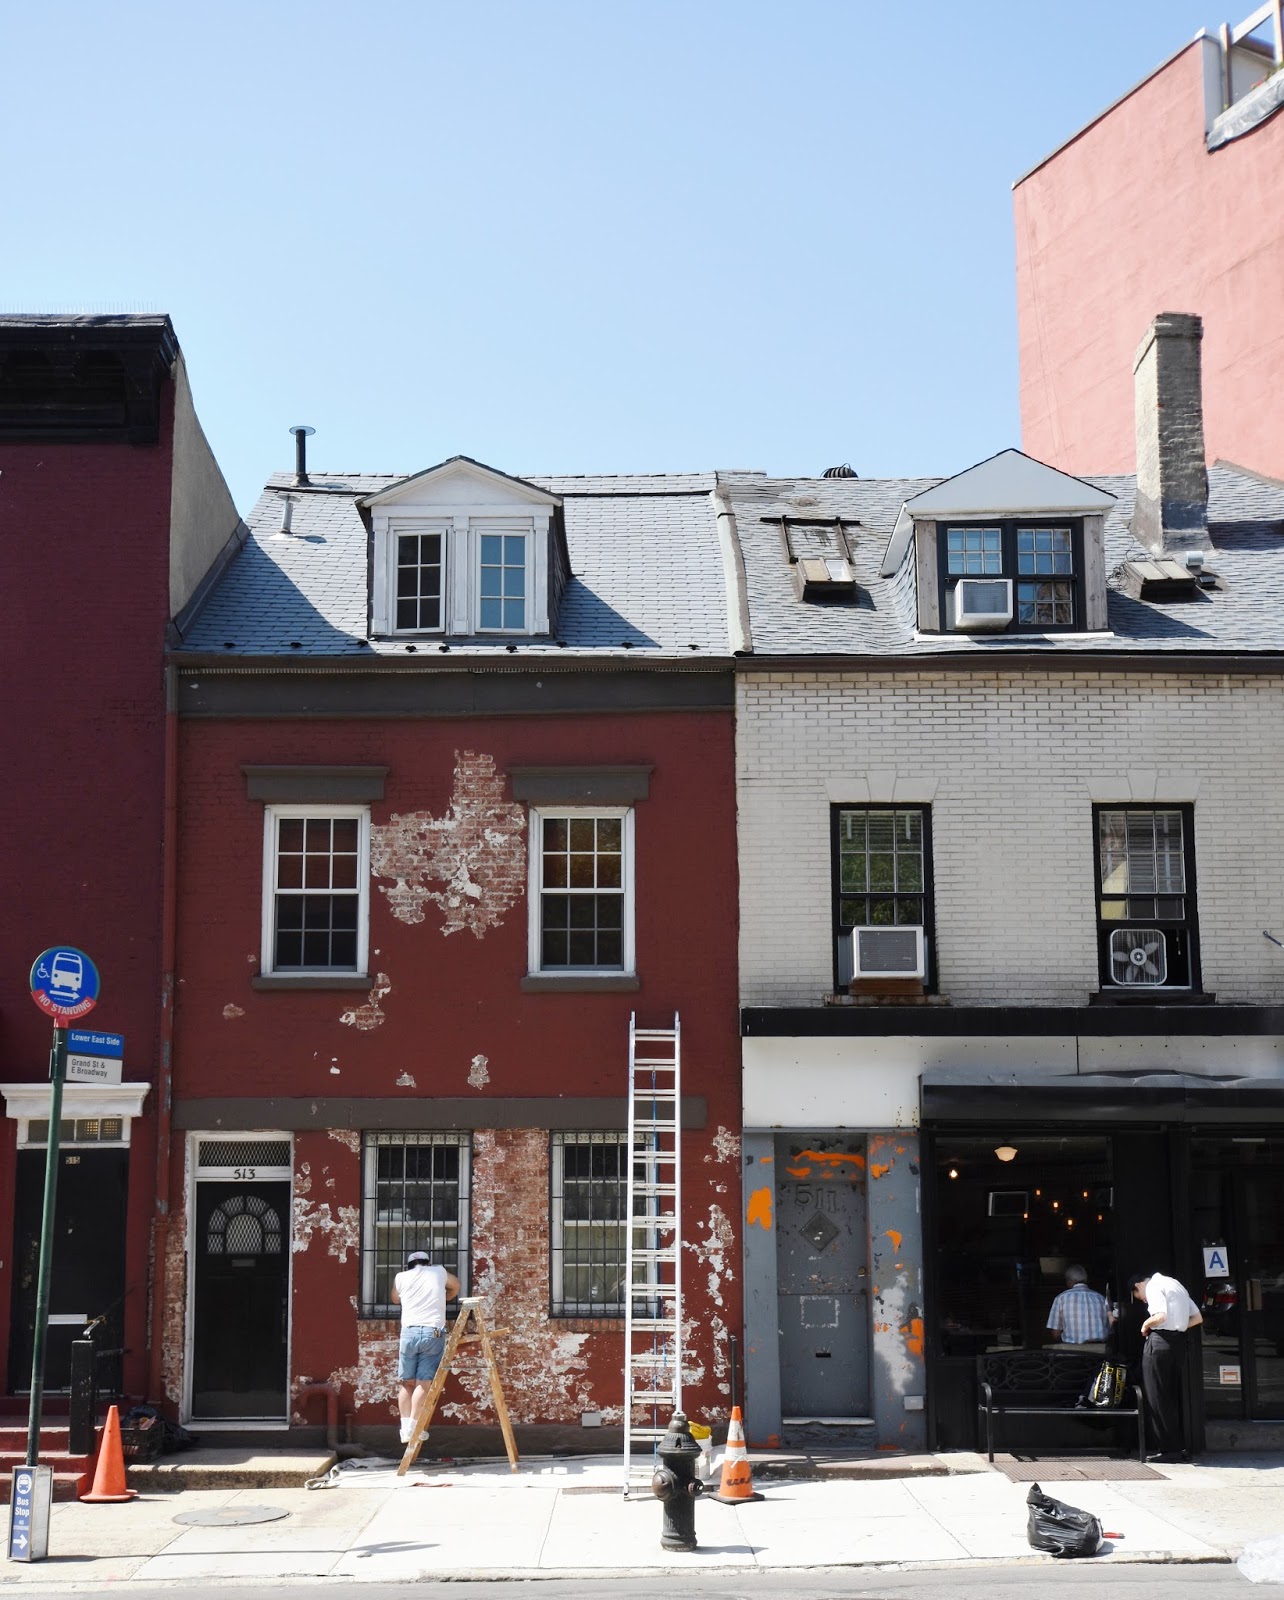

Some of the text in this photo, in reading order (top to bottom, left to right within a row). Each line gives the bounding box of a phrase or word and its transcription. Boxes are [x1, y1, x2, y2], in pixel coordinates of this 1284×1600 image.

[38, 993, 92, 1015] NO STANDING
[71, 1032, 120, 1046] Lower East Side
[71, 1058, 106, 1069] Grand St &
[71, 1066, 107, 1078] E Broadway
[233, 1168, 256, 1180] 513
[795, 1183, 837, 1214] 511
[1209, 1251, 1225, 1269] A
[16, 1496, 29, 1505] Bus
[14, 1506, 30, 1517] Stop
